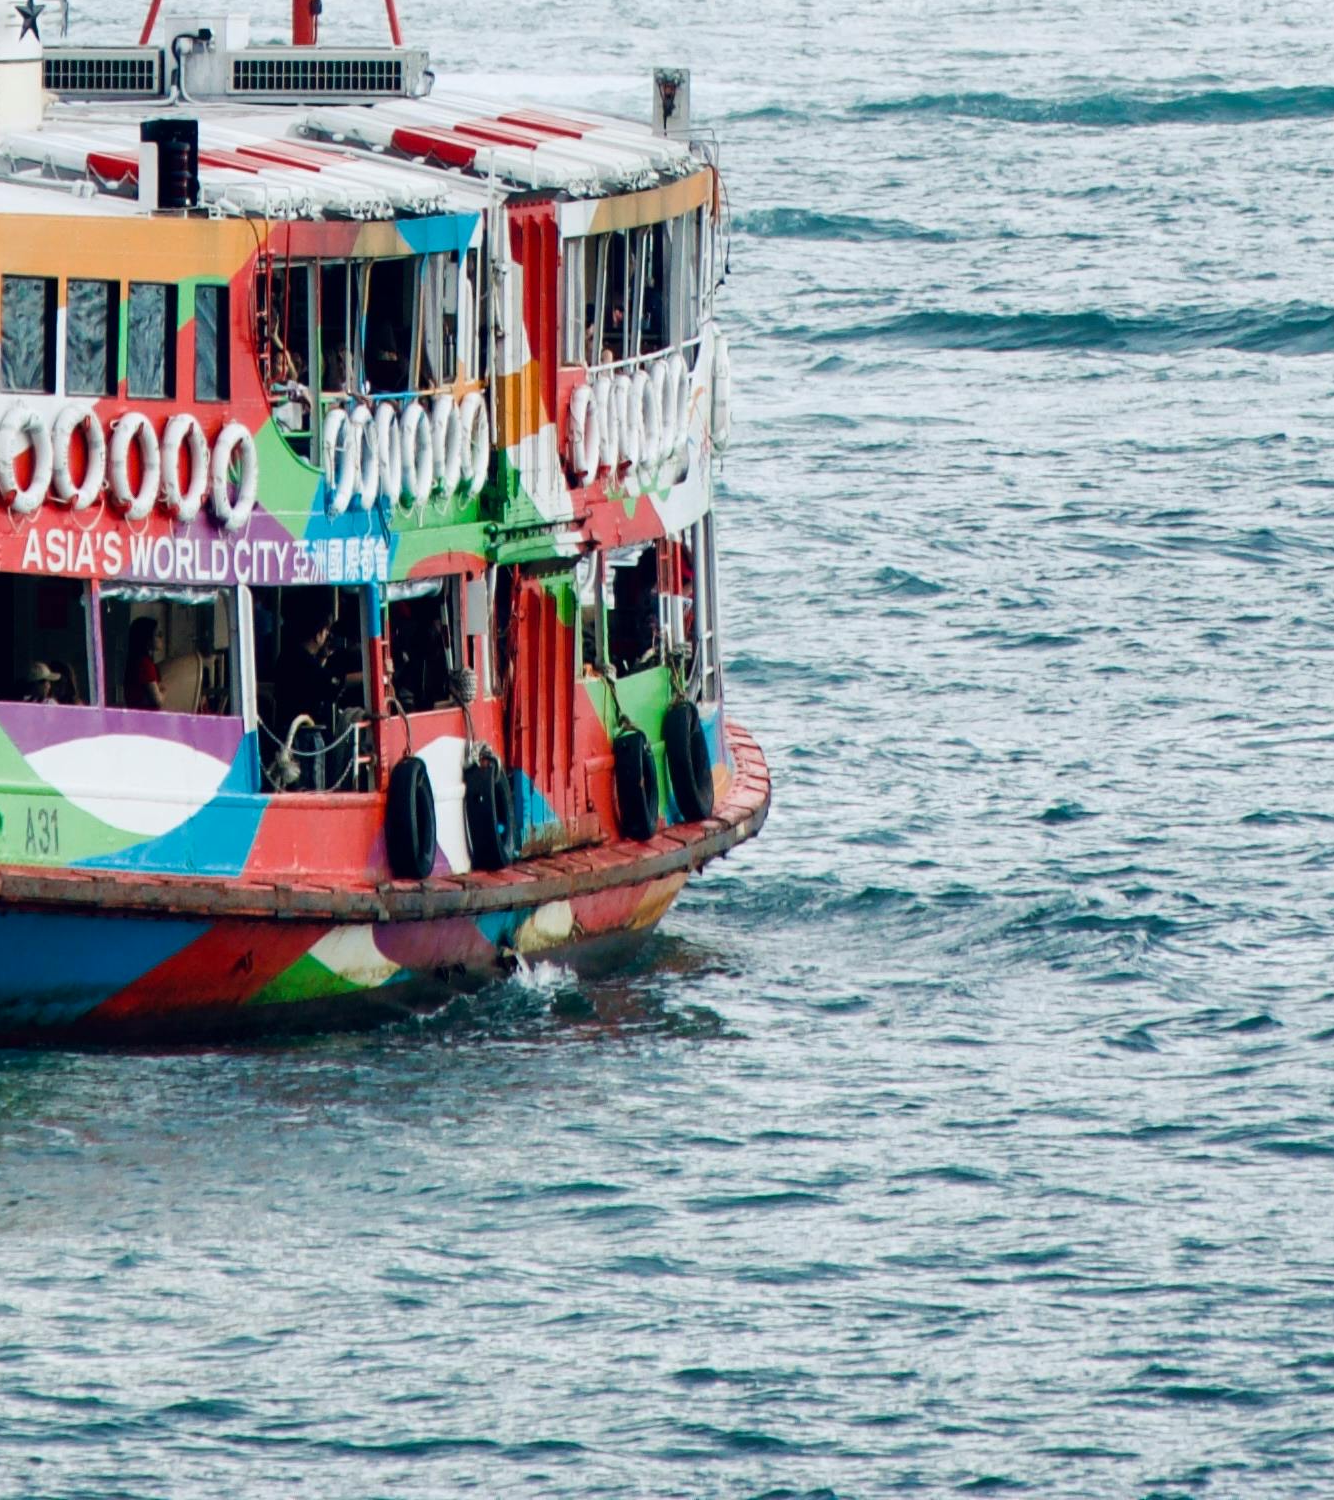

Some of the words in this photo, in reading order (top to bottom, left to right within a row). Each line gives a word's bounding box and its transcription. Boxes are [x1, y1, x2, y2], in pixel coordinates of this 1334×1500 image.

[21, 528, 123, 575] ASIA'S
[129, 535, 229, 581] WORLD
[233, 540, 290, 584] CITY
[291, 535, 390, 585] 亞洲國際都會
[25, 806, 59, 854] A31
